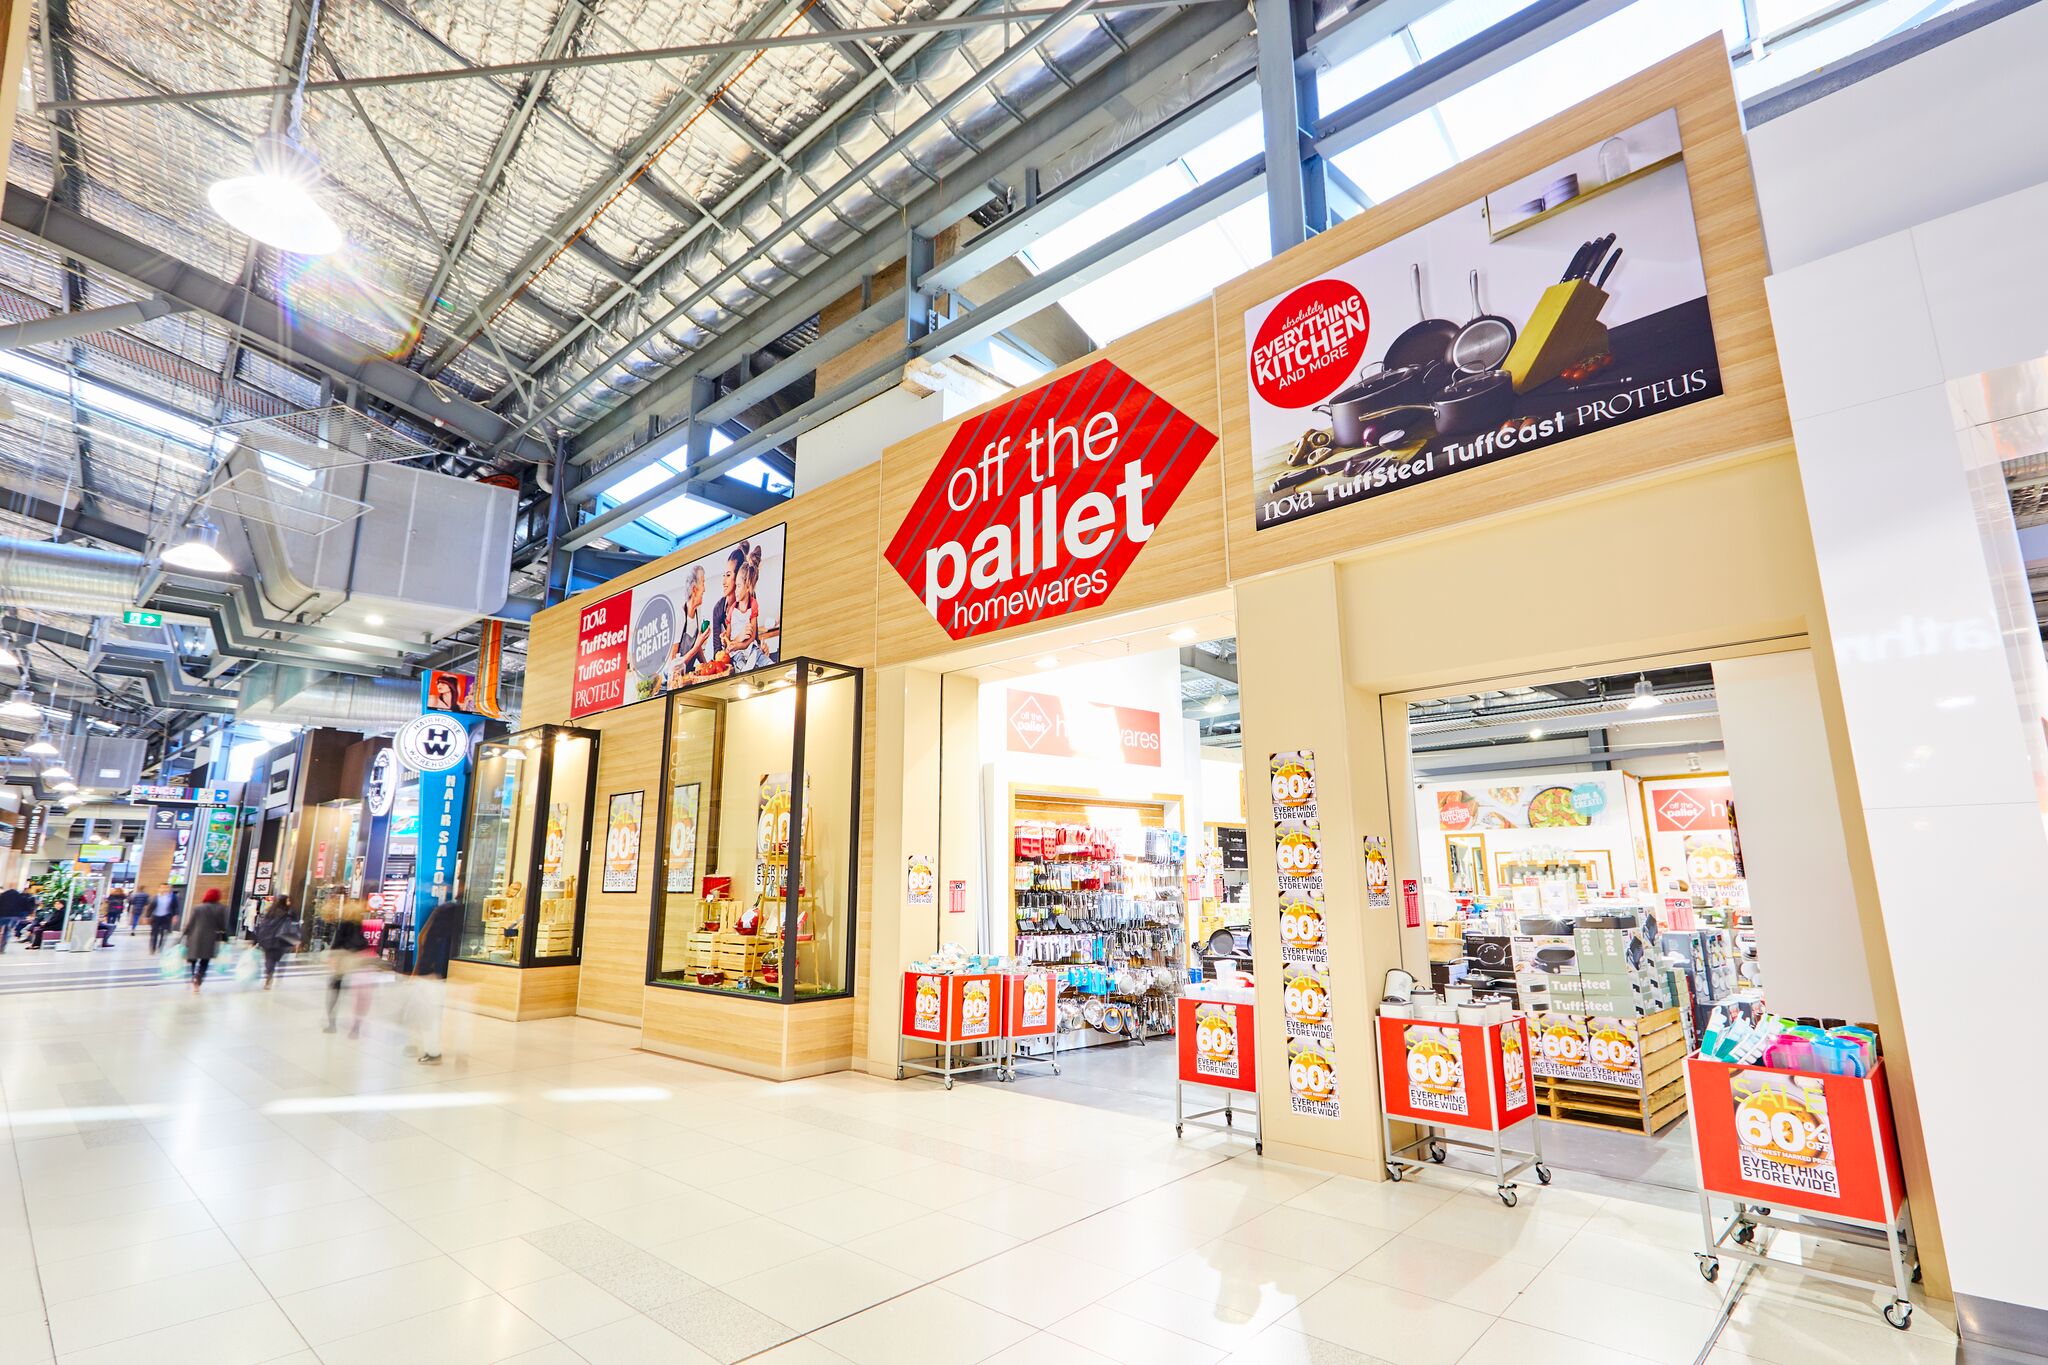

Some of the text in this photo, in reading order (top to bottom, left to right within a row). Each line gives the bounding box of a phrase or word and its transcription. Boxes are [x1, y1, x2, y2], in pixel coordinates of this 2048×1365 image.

[1282, 300, 1324, 331] absolutely
[1254, 295, 1360, 365] EVERYTHING
[1256, 309, 1366, 386] KITCHEN
[1279, 343, 1349, 390] AND MORE
[1262, 368, 1708, 523] nova TuffSteel TuffCast PROTEUS
[948, 410, 1119, 512] off the
[925, 459, 1155, 621] pallet
[954, 568, 1108, 630] homewares
[582, 606, 607, 633] nova
[636, 613, 669, 645] COOK &
[581, 624, 628, 656] TuffSteel
[635, 634, 670, 663] CREATE!
[578, 656, 621, 683] TuffCast
[574, 679, 621, 709] PROTEUS
[413, 717, 462, 734] HAIRHOUSE
[428, 728, 449, 742] H
[423, 742, 451, 756] W
[410, 753, 460, 768] WAREHOUSE
[1271, 755, 1314, 775] SALE
[1272, 774, 1316, 799] 60%
[1273, 805, 1317, 814] EVERYTHING
[1274, 811, 1318, 820] STOREWIDE!
[1667, 807, 1698, 818] pallet
[431, 775, 456, 906] HAIR SALON
[608, 826, 639, 860] 60%
[1276, 825, 1320, 843] SALE
[1277, 845, 1321, 869] 60%
[1279, 882, 1323, 890] STOREWIDE!
[1280, 897, 1324, 914] SALE
[1281, 915, 1326, 941] 60%
[1282, 947, 1327, 956] EVERYTHING
[1283, 953, 1328, 963] STOREWIDE!
[1284, 970, 1329, 987] SALE
[1284, 988, 1330, 1014] 60%
[1197, 1009, 1236, 1026] SALE
[1286, 1020, 1332, 1032] EVERYTHING
[1543, 1018, 1589, 1037] SALE
[1196, 1027, 1237, 1052] 60%
[1287, 1028, 1333, 1039] STOREWIDE!
[1590, 1022, 1636, 1041] SALE
[1288, 1043, 1335, 1065] SALE
[1407, 1031, 1459, 1055] SALE
[1542, 1035, 1589, 1058] 60%
[1590, 1038, 1638, 1064] 60%
[1197, 1058, 1237, 1069] EVERYTHING
[1198, 1065, 1238, 1076] STOREWIDE!
[1407, 1053, 1462, 1084] 60%
[1545, 1063, 1591, 1073] EVERYTHING
[1546, 1069, 1592, 1080] STOREWIDE!
[1593, 1067, 1641, 1079] EVERYTHING
[1290, 1064, 1337, 1092] 60%
[1292, 1097, 1339, 1110] EVERYTHING
[1410, 1090, 1465, 1104] EVERYTHING
[1411, 1098, 1467, 1112] STOREWIDE!
[1733, 1078, 1825, 1115] SALE
[1293, 1104, 1340, 1118] STOREWIDE!
[1736, 1108, 1829, 1152] 60%
[1754, 1147, 1782, 1157] LOWEST
[1782, 1152, 1811, 1162] MARKED
[1806, 1141, 1829, 1152] OFF
[1742, 1155, 1835, 1182] EVERYTHING
[1744, 1166, 1837, 1194] STOREWIDE!
